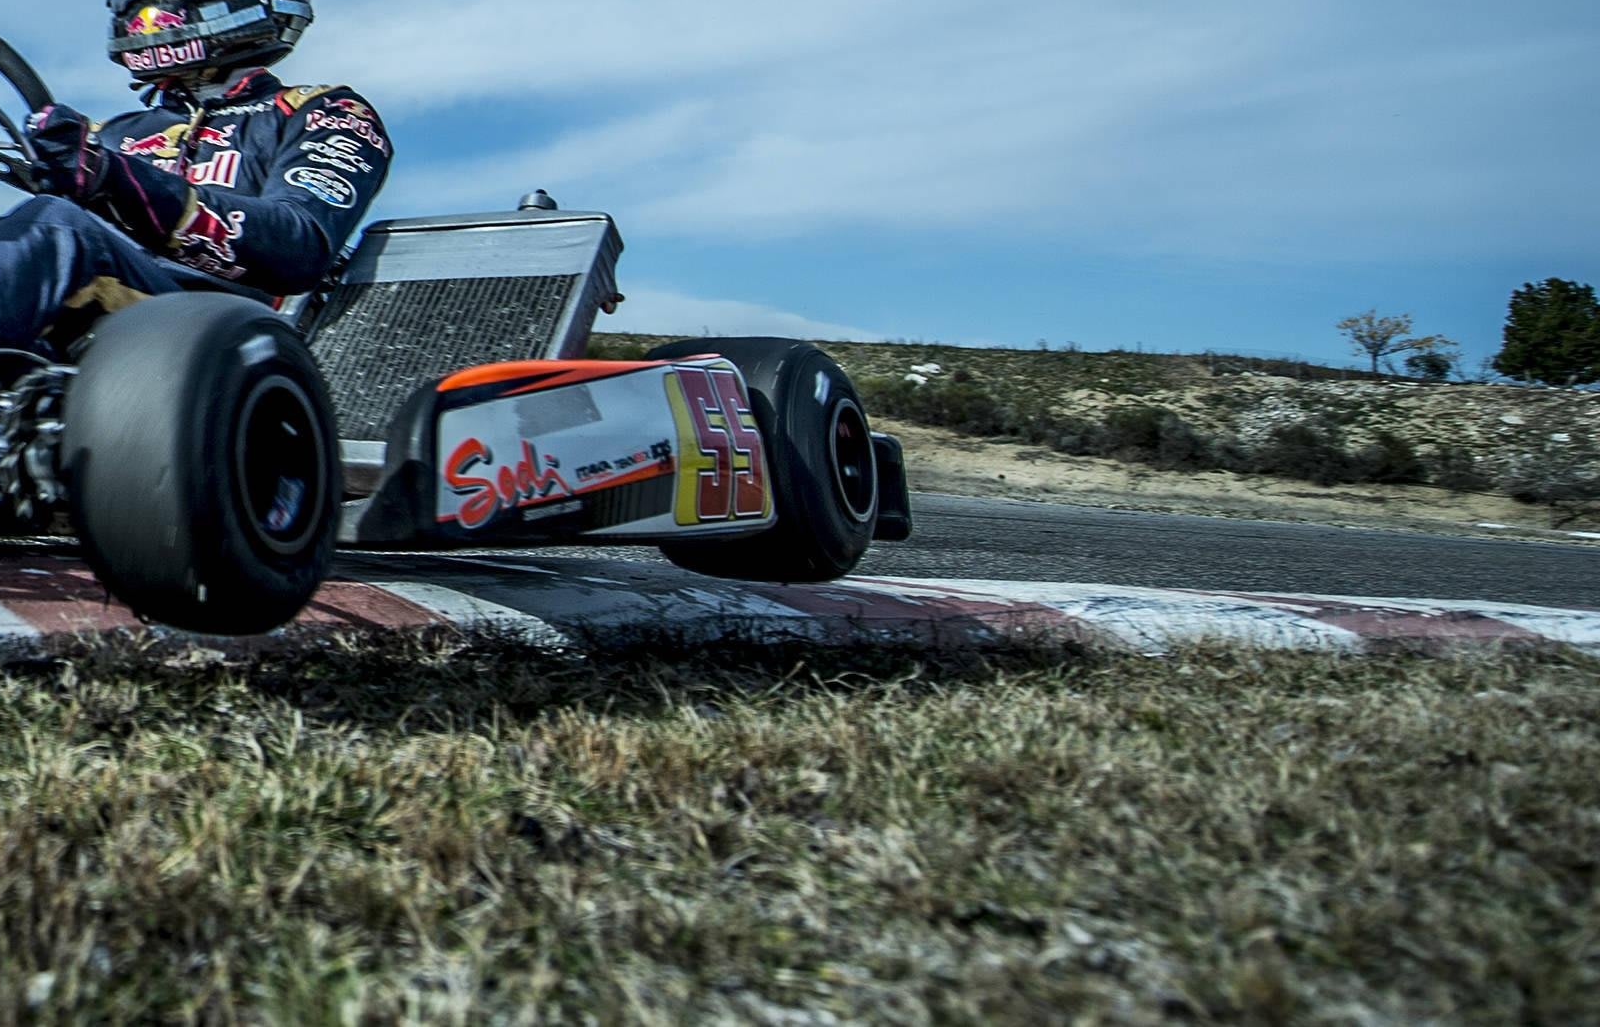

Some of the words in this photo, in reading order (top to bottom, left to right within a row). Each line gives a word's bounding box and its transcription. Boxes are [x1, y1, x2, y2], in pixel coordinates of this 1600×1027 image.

[155, 38, 206, 67] Bull
[305, 109, 357, 132] Red
[353, 120, 391, 158] Bu
[672, 366, 767, 520] 55
[443, 437, 572, 529] Sodi
